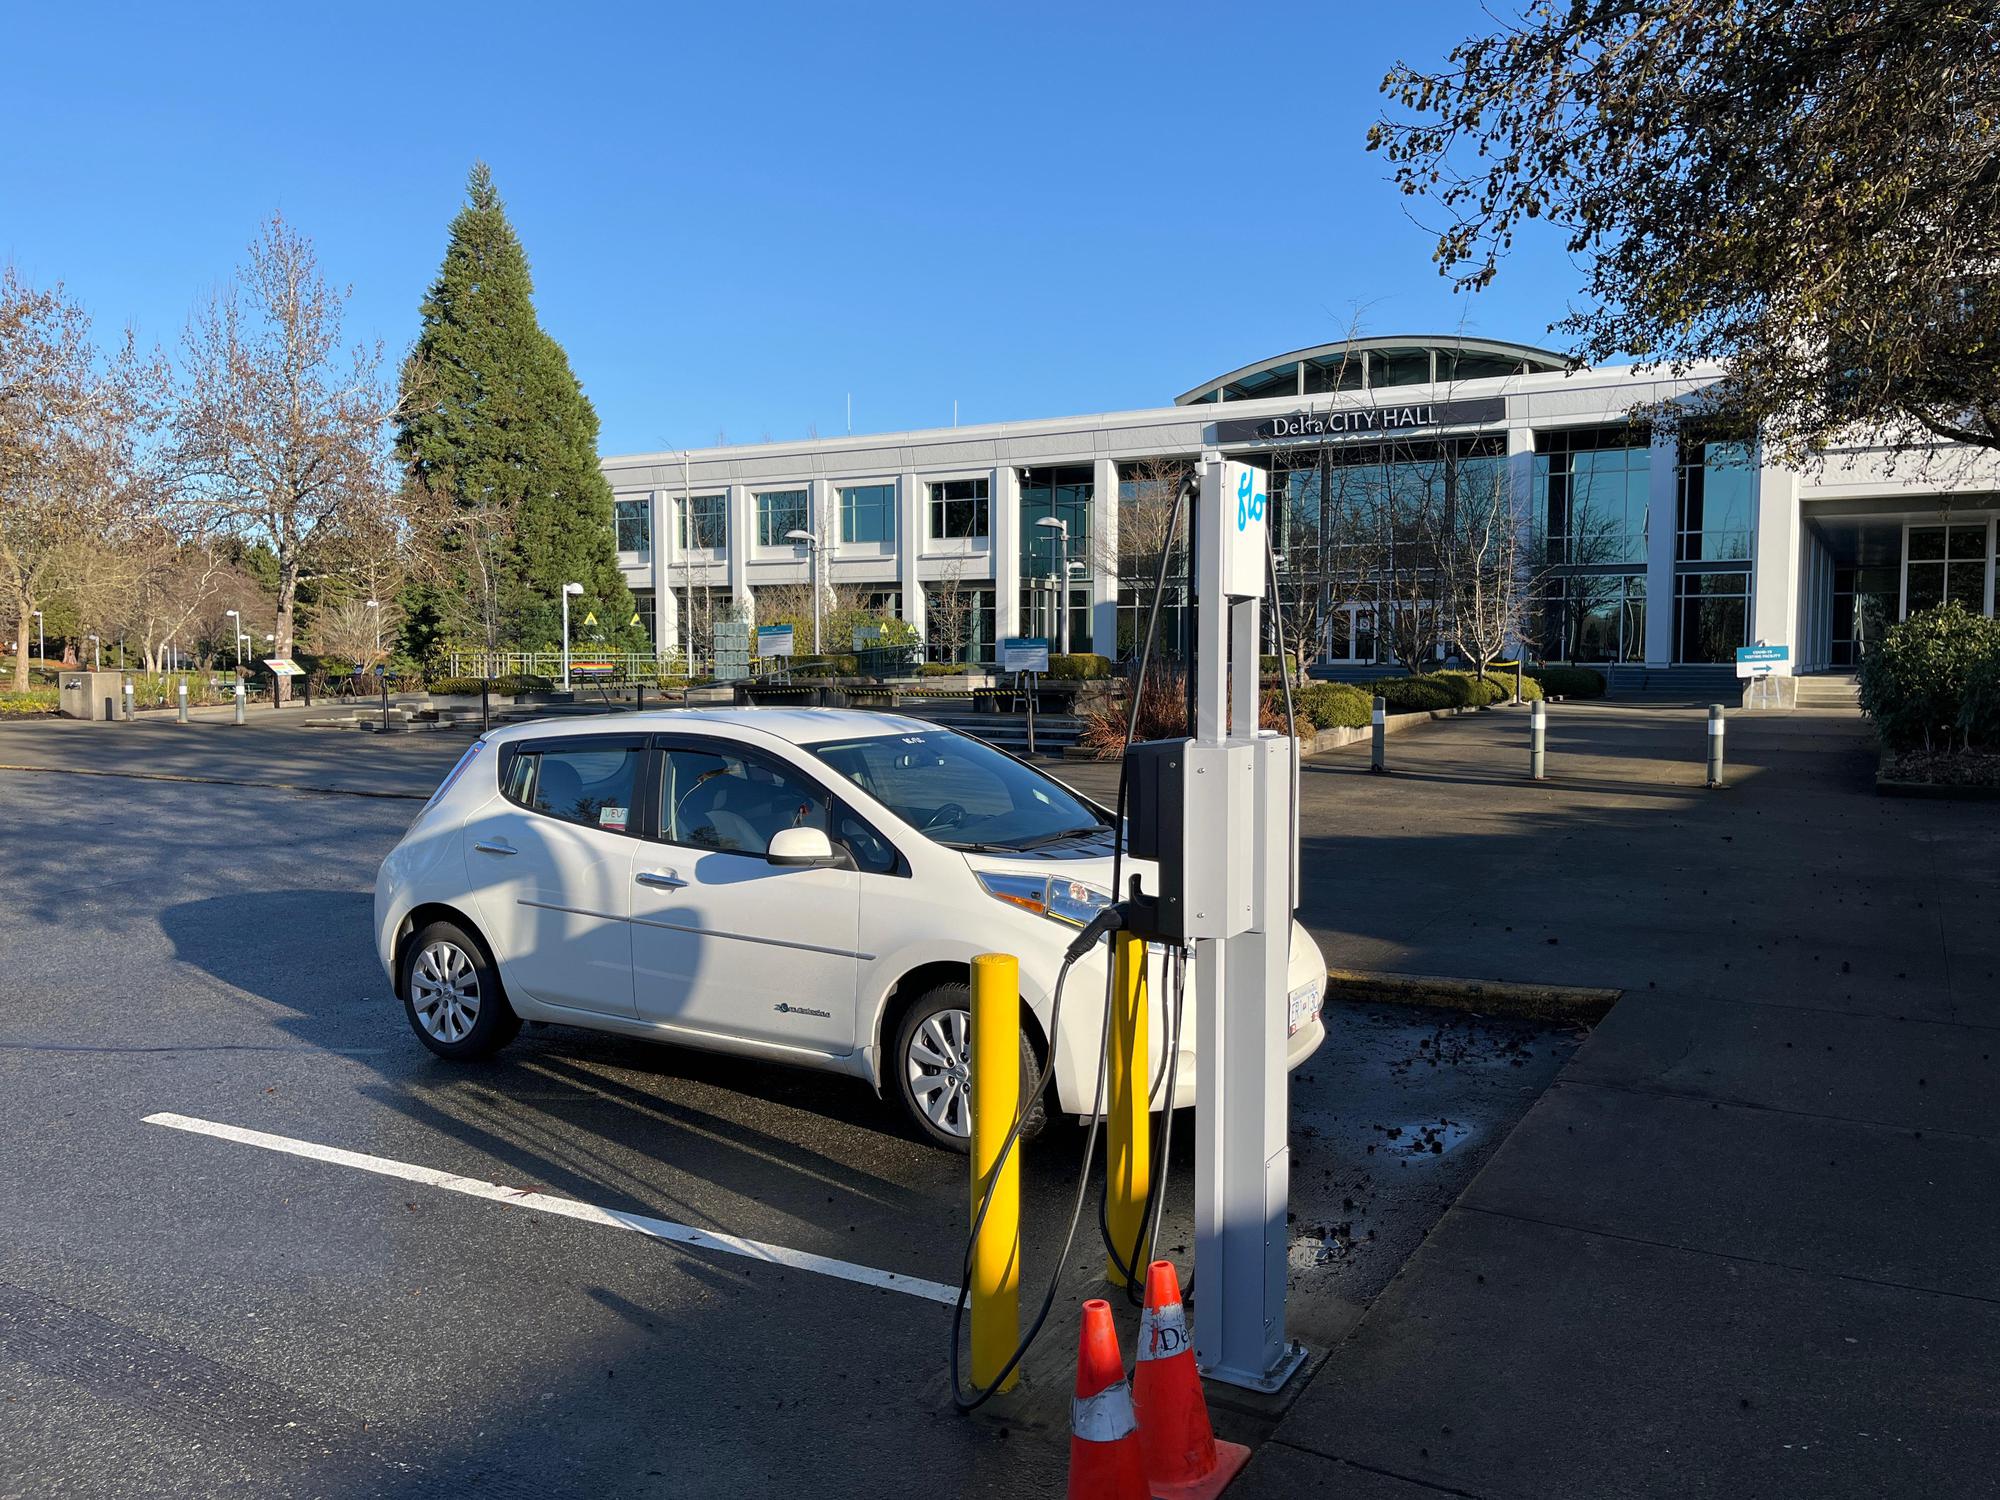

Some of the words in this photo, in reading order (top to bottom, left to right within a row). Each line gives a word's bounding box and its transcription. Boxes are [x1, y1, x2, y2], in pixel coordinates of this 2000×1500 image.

[1272, 402, 1324, 436] Delta
[1330, 411, 1376, 432] CITY
[1384, 406, 1439, 428] HALL
[1237, 467, 1267, 532] flo
